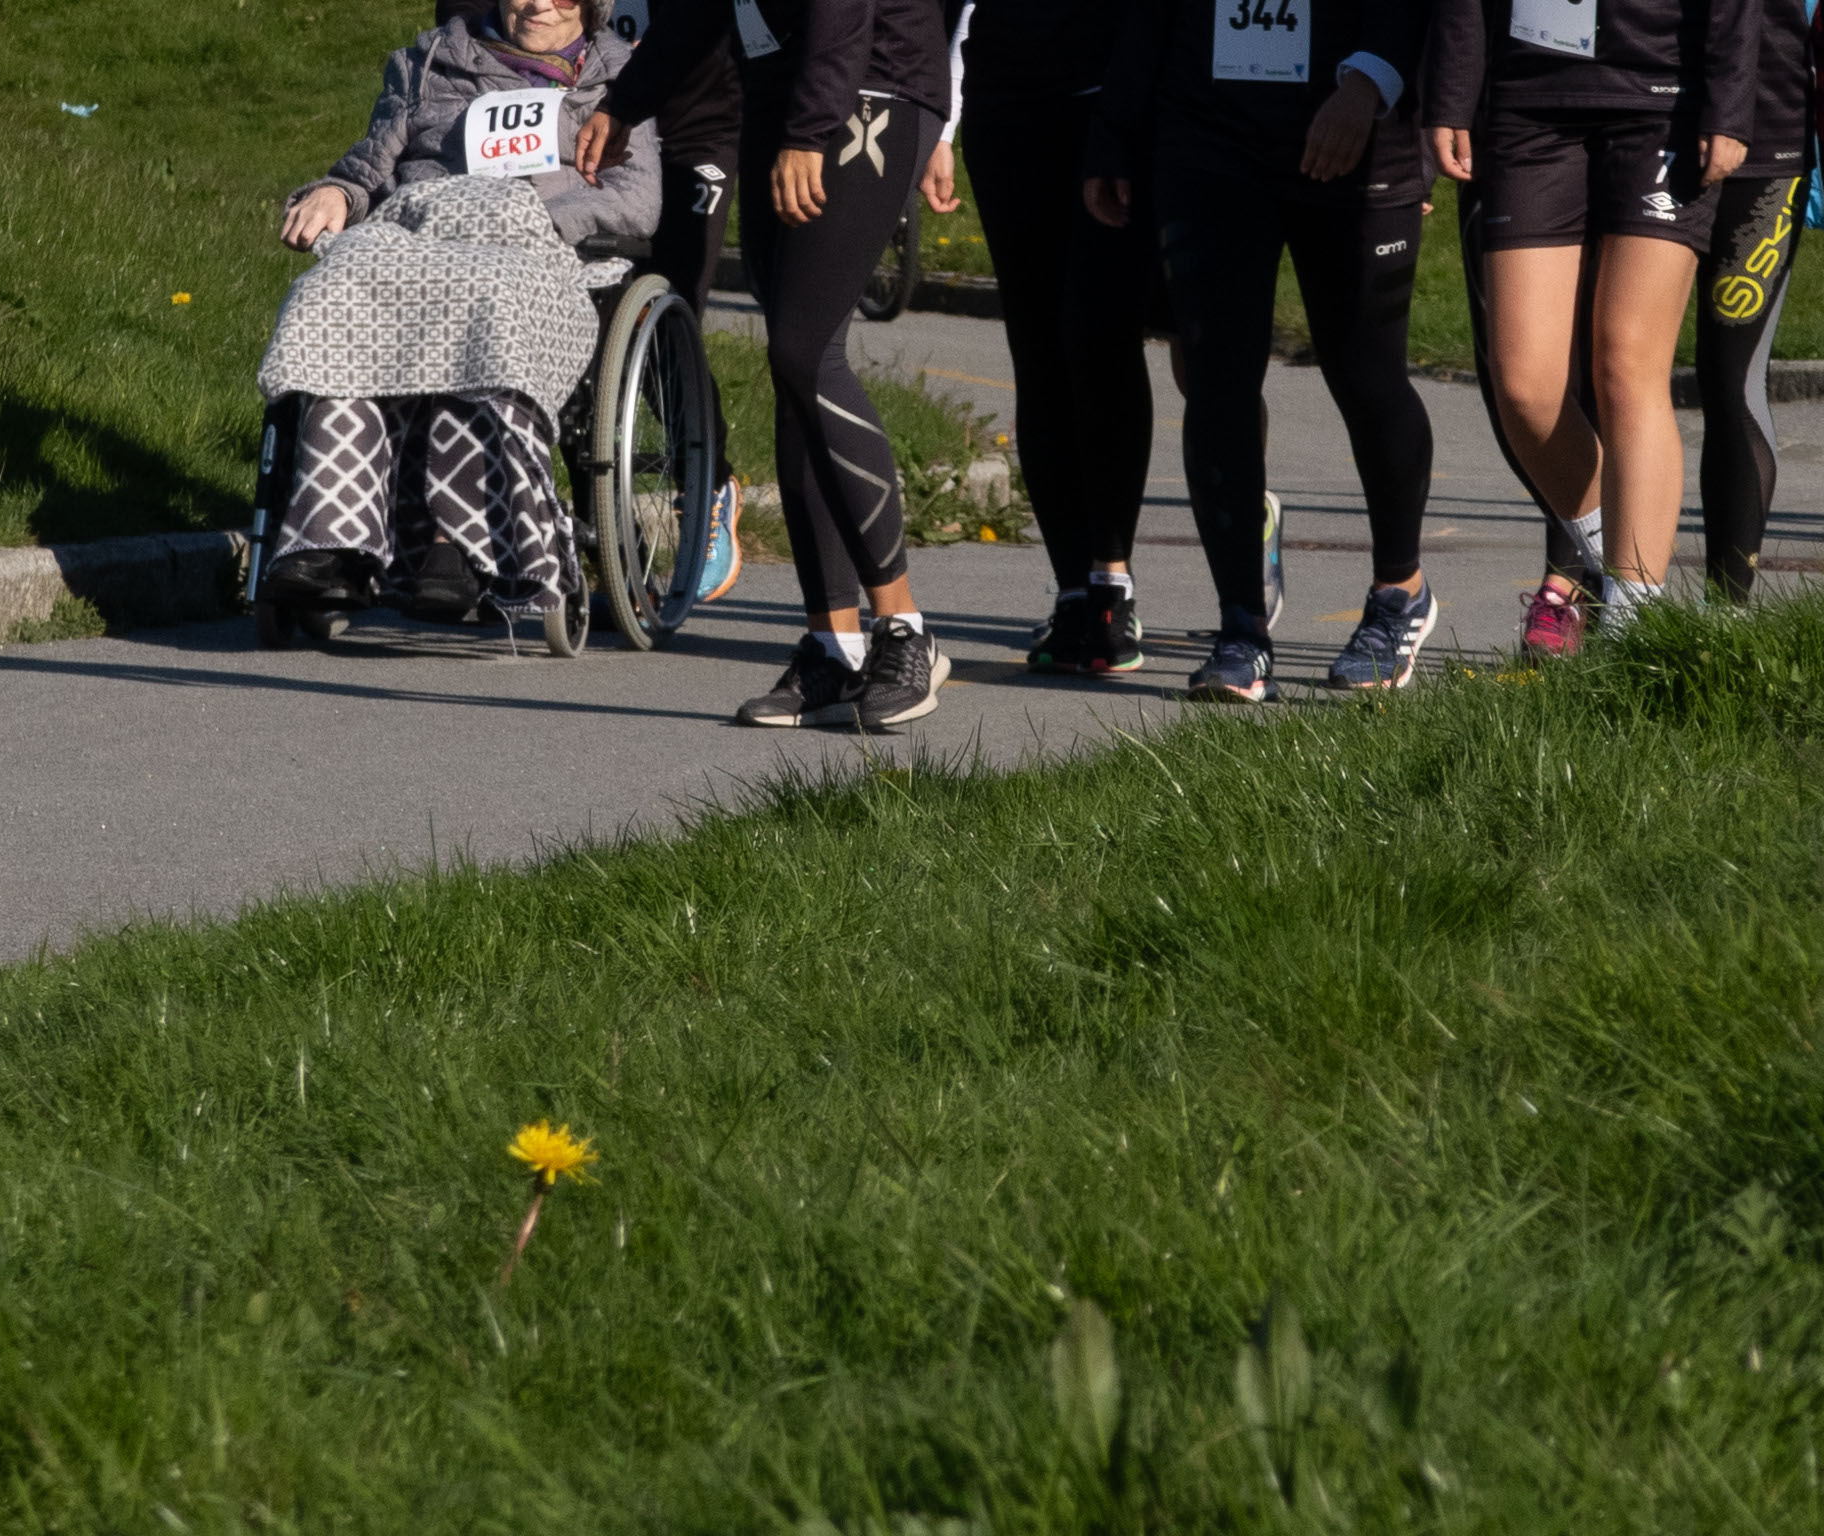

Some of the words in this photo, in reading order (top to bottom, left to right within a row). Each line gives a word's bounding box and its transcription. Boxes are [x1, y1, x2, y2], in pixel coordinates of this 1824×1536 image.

[485, 102, 545, 133] 103
[481, 133, 541, 159] GERD
[1656, 150, 1676, 184] 7
[692, 183, 723, 215] 27
